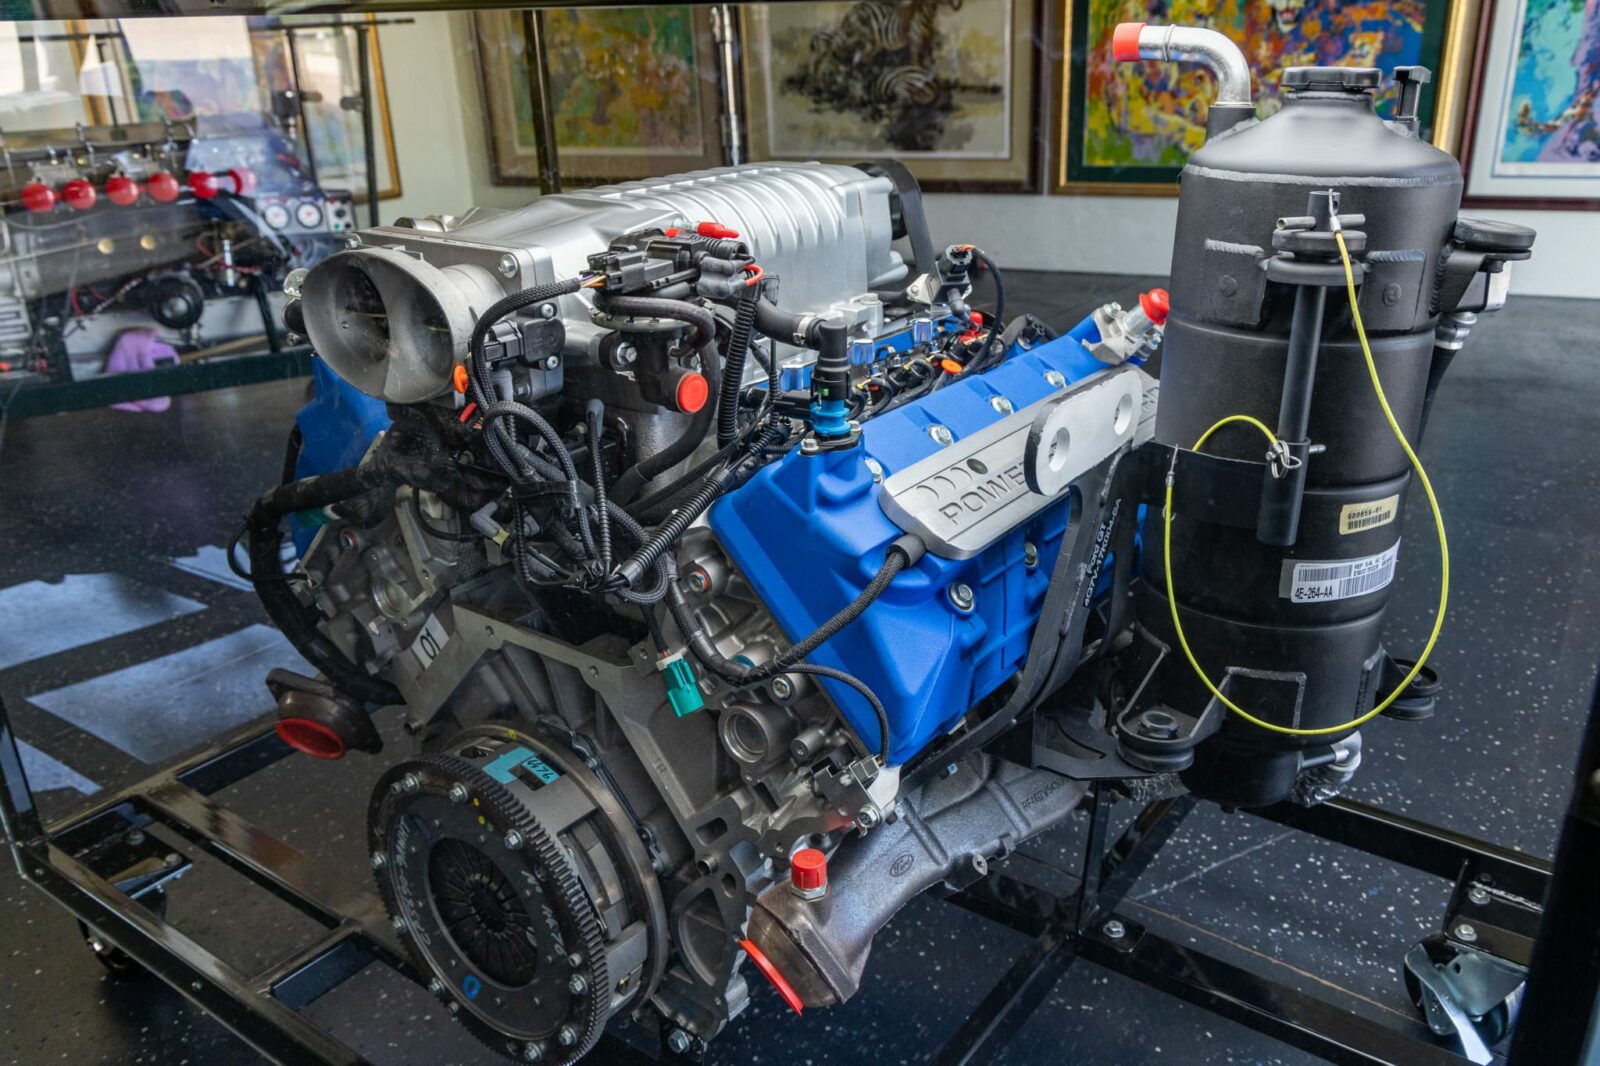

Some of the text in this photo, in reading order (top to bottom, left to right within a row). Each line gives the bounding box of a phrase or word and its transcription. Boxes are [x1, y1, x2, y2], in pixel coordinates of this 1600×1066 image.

[938, 460, 1024, 524] POWE
[1087, 521, 1106, 574] Ford GT
